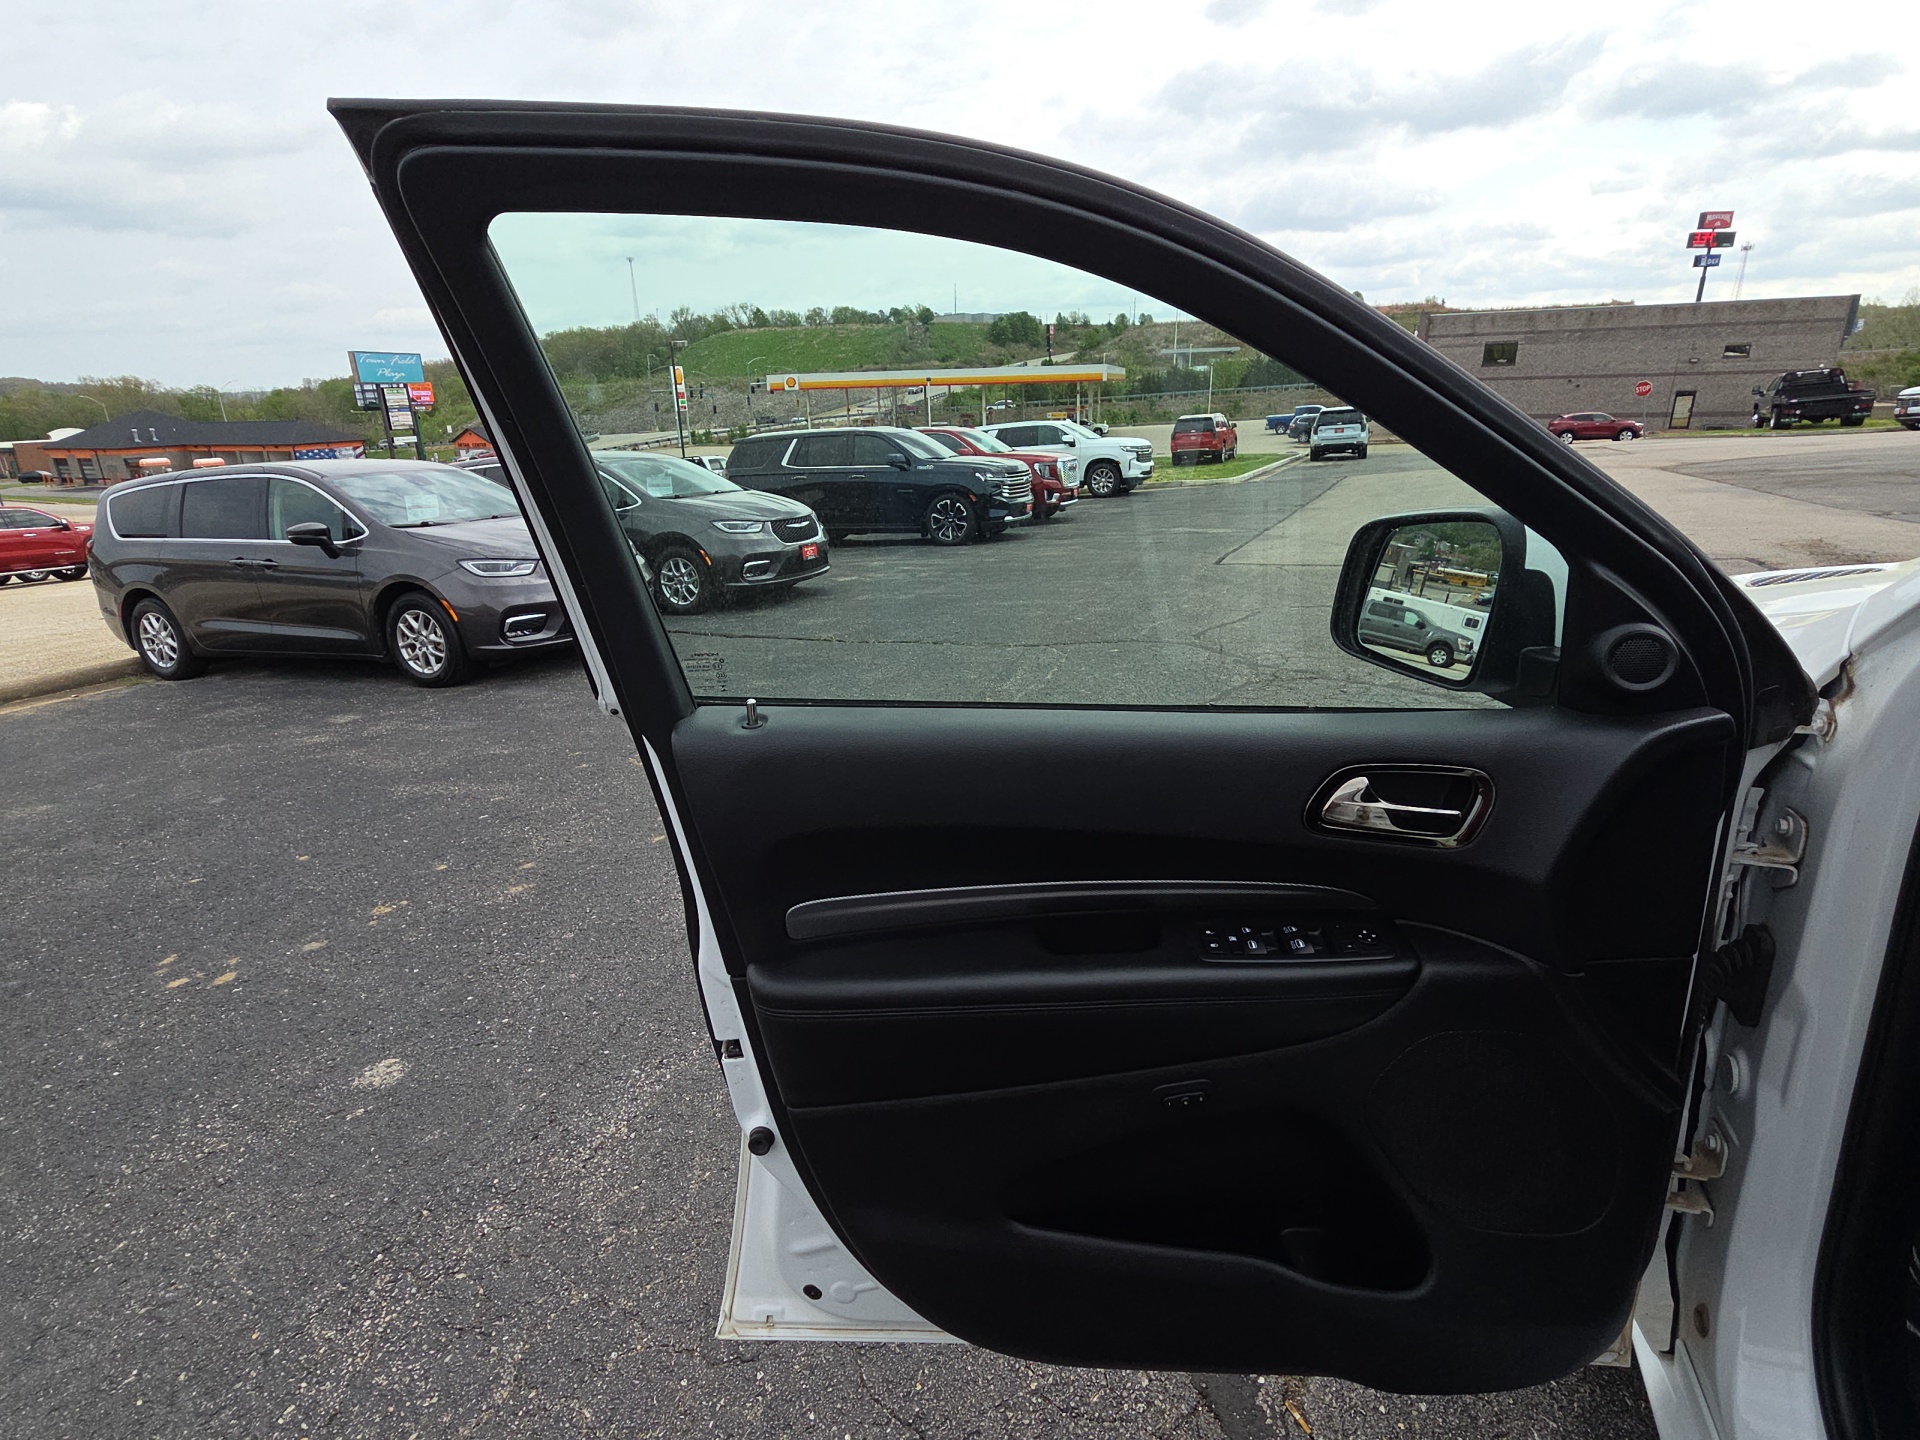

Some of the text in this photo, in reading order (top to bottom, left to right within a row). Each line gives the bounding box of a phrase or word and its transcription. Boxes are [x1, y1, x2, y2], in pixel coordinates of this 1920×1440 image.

[359, 353, 417, 366] Town Field
[376, 367, 406, 381] Plaza
[1635, 384, 1651, 394] STOP
